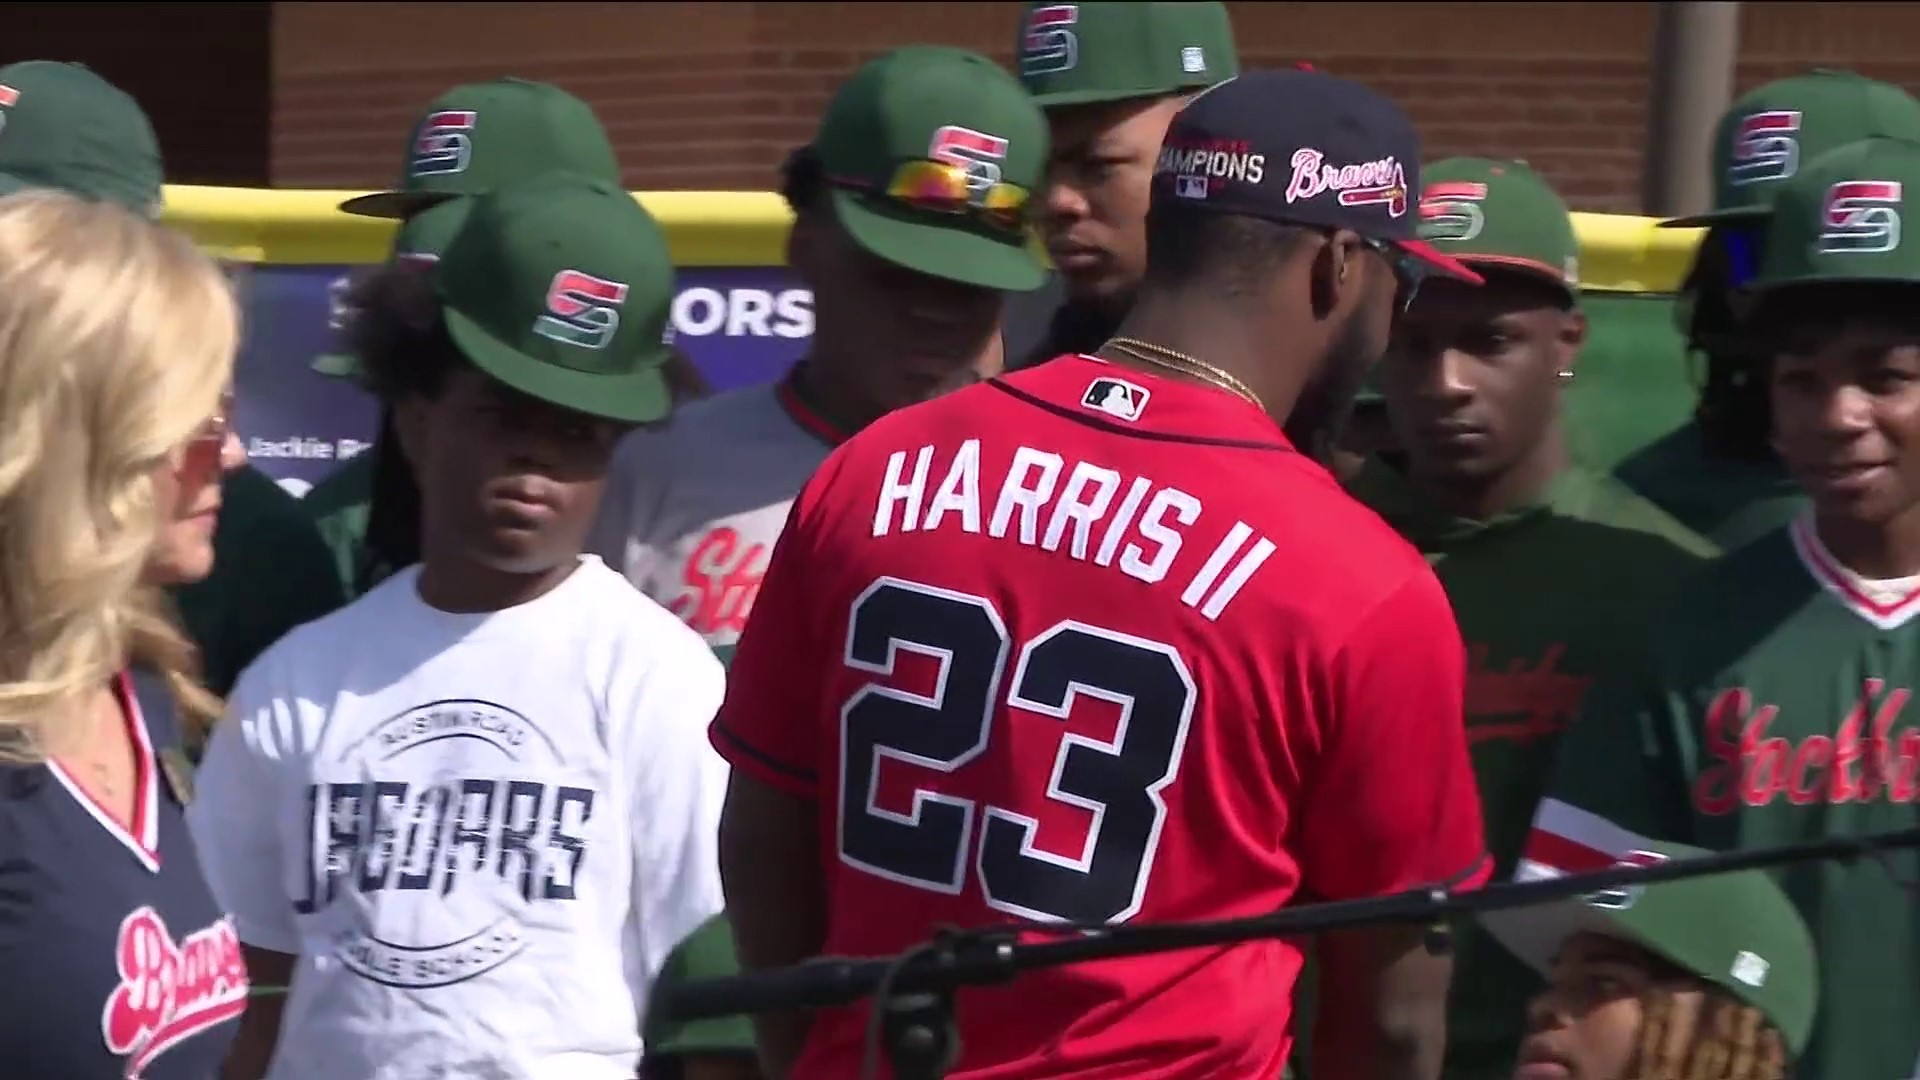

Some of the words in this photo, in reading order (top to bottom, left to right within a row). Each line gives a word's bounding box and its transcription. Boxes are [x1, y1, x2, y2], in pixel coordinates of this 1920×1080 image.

[248, 436, 334, 459] Jackie
[872, 438, 1203, 584] HARRIS
[1180, 519, 1277, 621] II
[836, 575, 1198, 928] 23
[292, 777, 595, 915] JAGUARS
